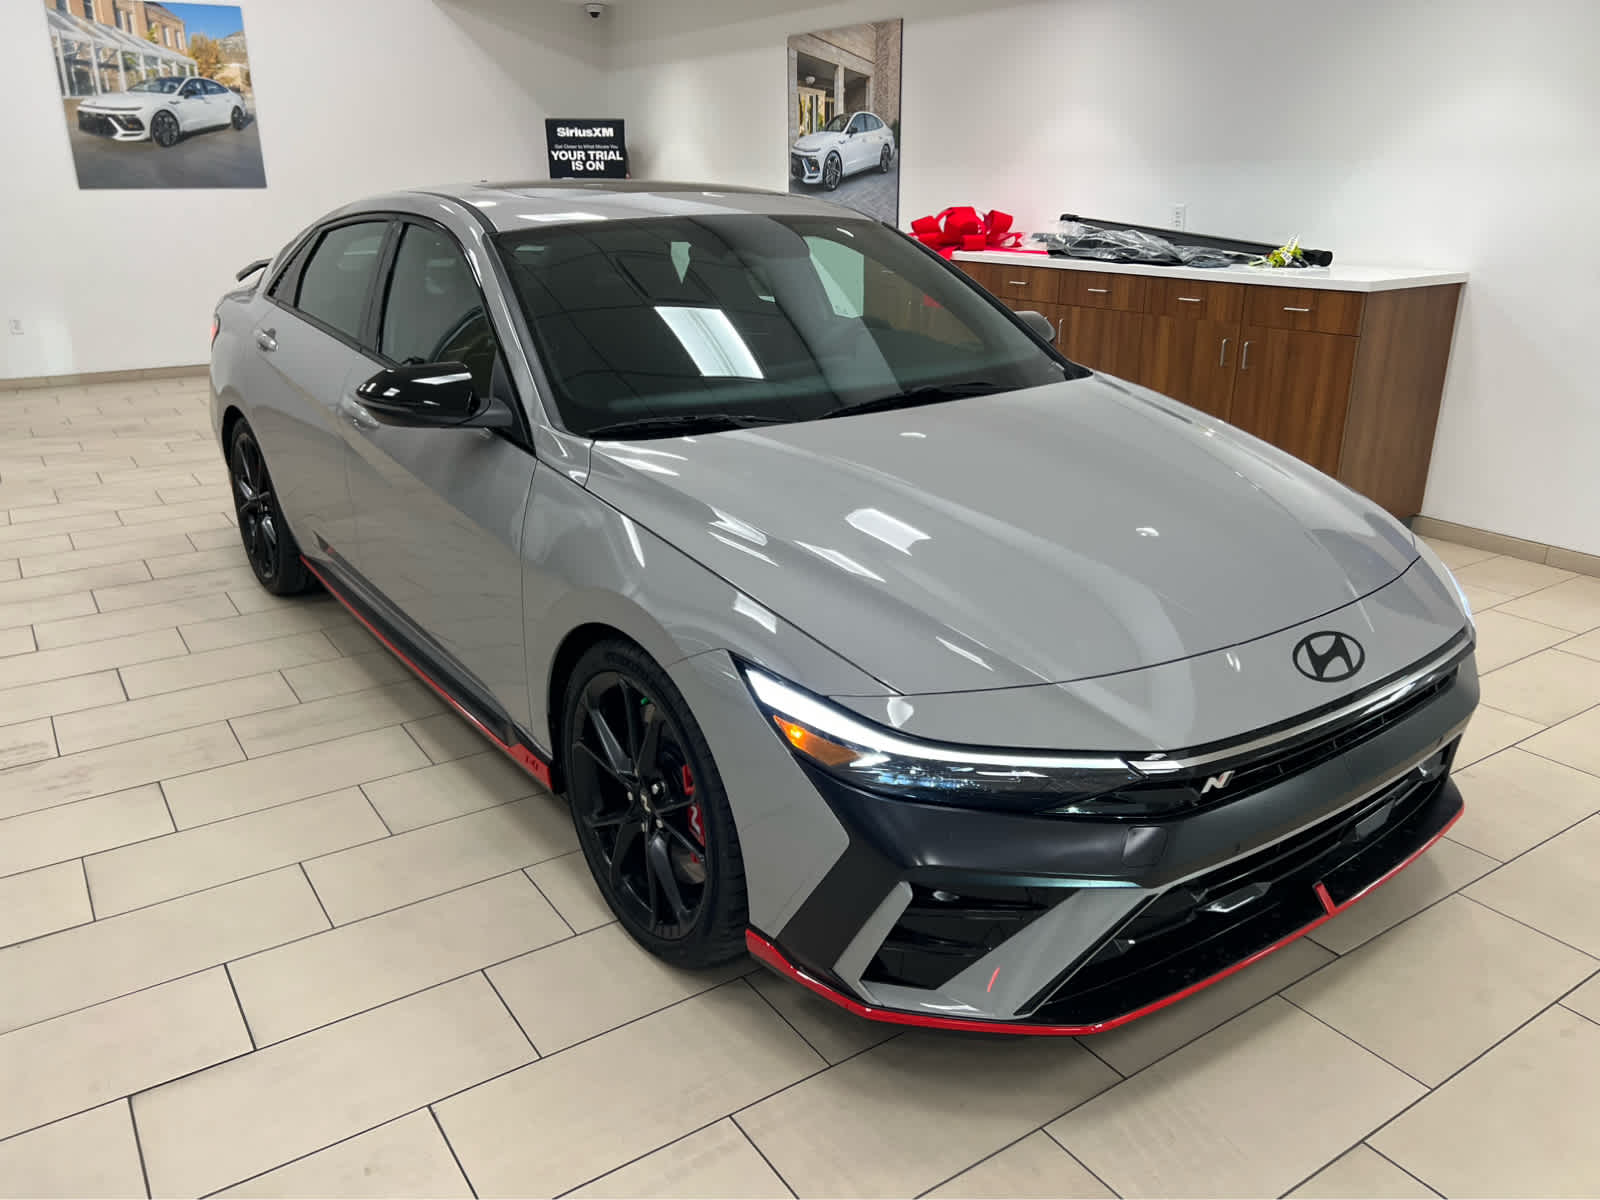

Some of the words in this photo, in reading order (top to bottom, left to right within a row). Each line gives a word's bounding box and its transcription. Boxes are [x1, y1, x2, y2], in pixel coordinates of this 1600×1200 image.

[556, 127, 614, 137] SiriusXM
[551, 150, 586, 161] YOUR
[587, 150, 624, 161] TRIAL
[571, 160, 584, 171] IS
[586, 160, 605, 171] ON
